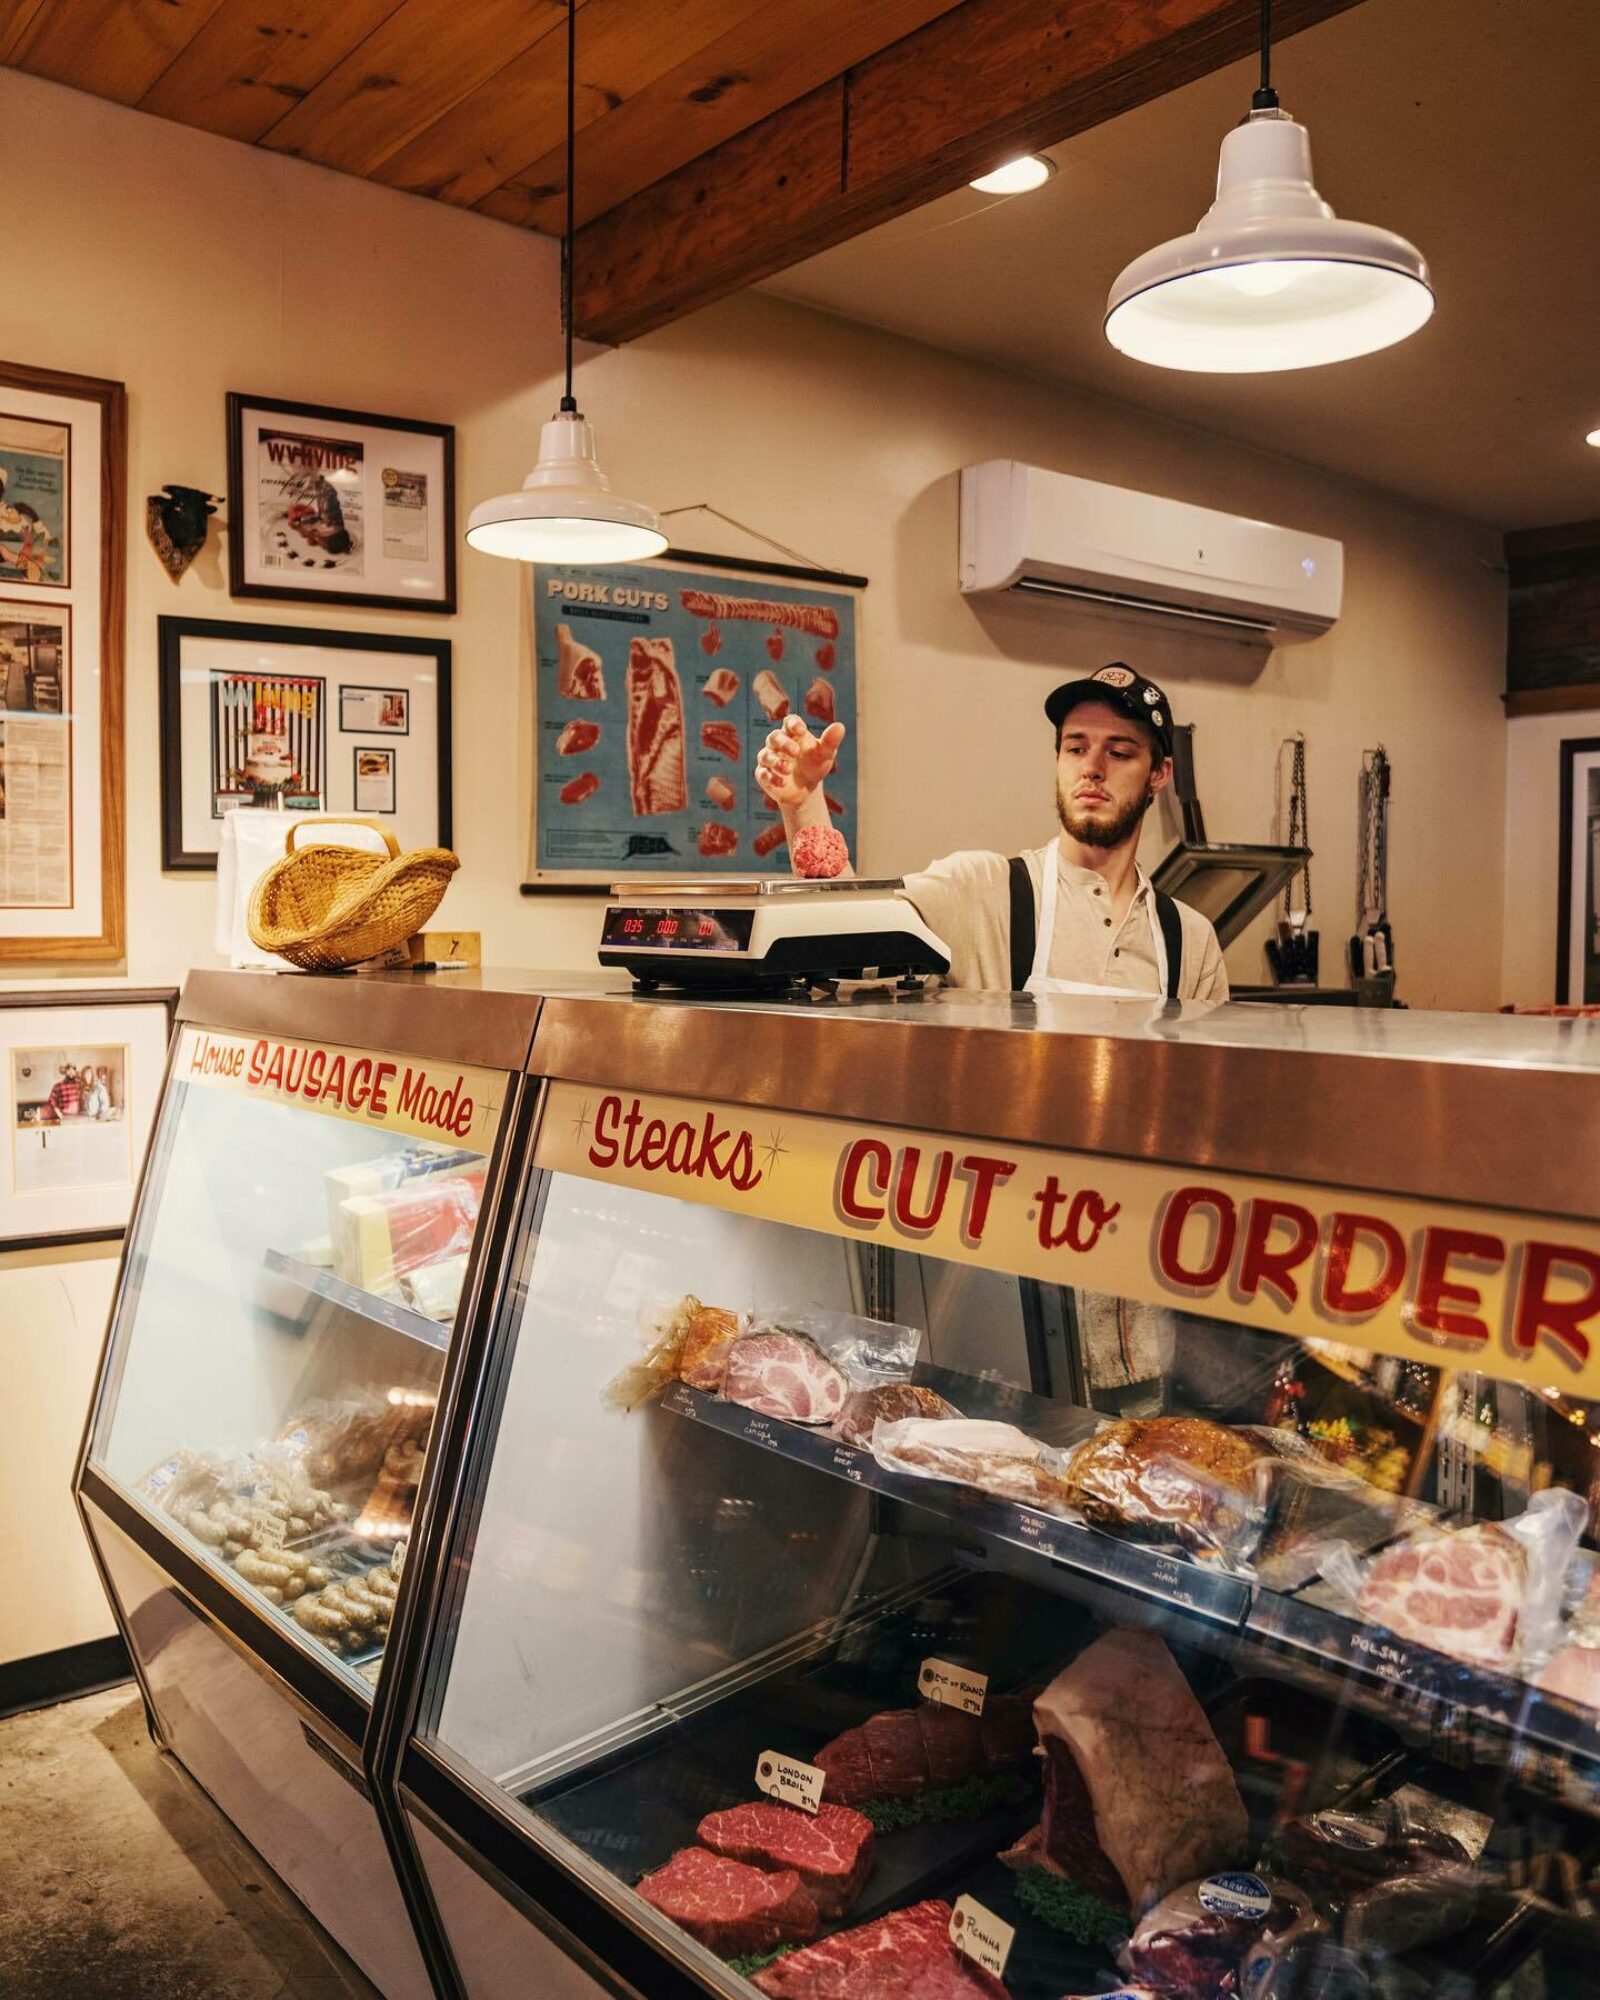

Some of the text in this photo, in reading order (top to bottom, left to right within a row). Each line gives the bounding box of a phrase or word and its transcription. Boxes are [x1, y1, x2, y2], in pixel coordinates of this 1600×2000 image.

[548, 579, 668, 611] PORK CUTS
[190, 1035, 474, 1138] House SAUSAGE Made
[589, 1096, 1600, 1372] Steaks CUT to ORDER
[777, 1763, 813, 1785] LONDON
[780, 1775, 805, 1792] BROIL
